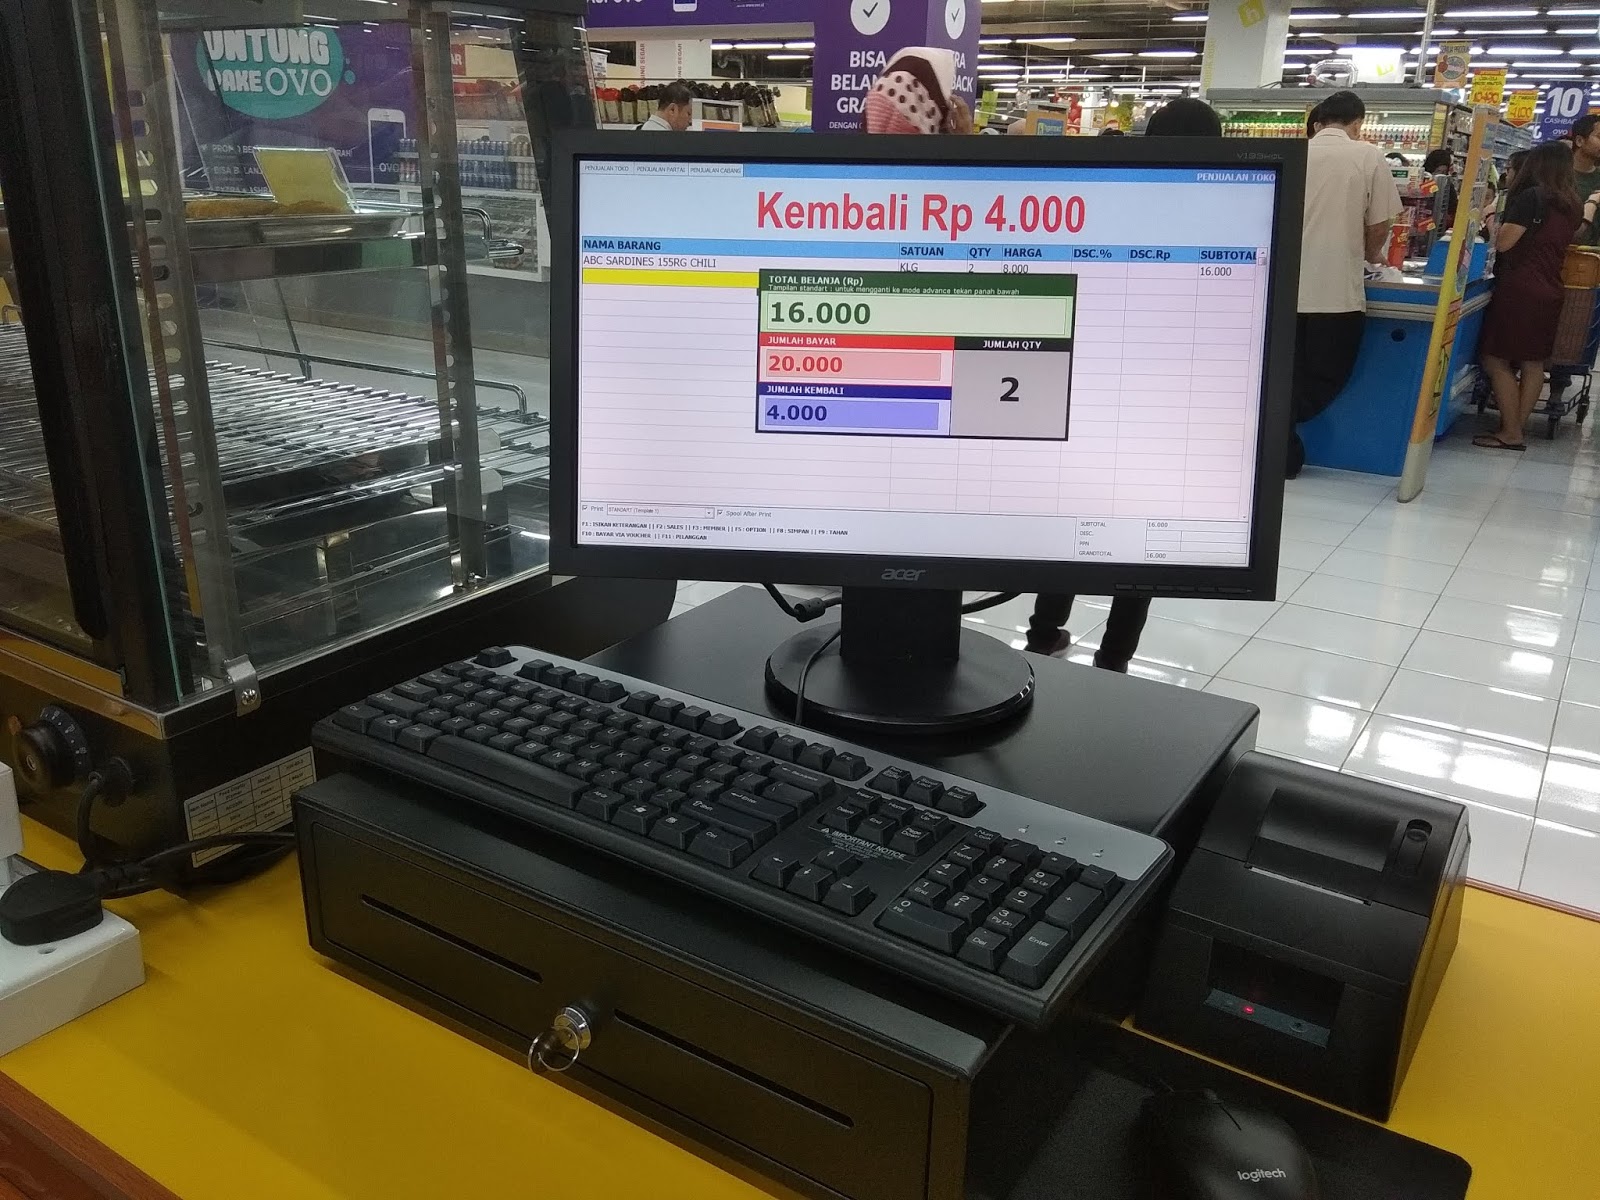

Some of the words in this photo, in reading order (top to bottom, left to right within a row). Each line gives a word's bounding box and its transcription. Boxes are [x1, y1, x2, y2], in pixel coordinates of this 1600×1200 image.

[203, 28, 330, 65] UNTUNG
[850, 51, 887, 68] BISA
[265, 67, 332, 97] OVO
[831, 74, 876, 91] BELA
[829, 121, 858, 129] DENGAN
[1197, 172, 1249, 182] PENJUALAN
[1252, 173, 1276, 182] TOKO
[757, 191, 907, 232] Kembali
[921, 194, 973, 241] Rp
[984, 194, 1086, 233] 4.000
[583, 239, 615, 250] NAMA
[617, 240, 661, 251] BARANG
[900, 246, 944, 257] SATUAN
[969, 248, 991, 259] QTY
[1003, 248, 1042, 258] HARGA
[1073, 249, 1112, 259] DSC.%
[1130, 250, 1170, 261] DSC.Rp
[583, 255, 603, 265] ABC
[606, 256, 654, 267] SARDINES
[657, 257, 687, 267] 155RG
[690, 258, 717, 268] CHILI
[900, 263, 918, 272] KLG
[968, 264, 974, 273] 2
[1003, 264, 1029, 273] 8.000
[1200, 267, 1232, 277] 16.000
[769, 275, 799, 284] TOTAL
[801, 276, 841, 286] BELANJA
[842, 276, 864, 287] (Rp)
[768, 285, 798, 293] Tampilan
[799, 285, 828, 293] standart
[856, 287, 891, 295] mengganti
[770, 301, 871, 325] 16.000
[768, 336, 804, 345] JUMLAH
[807, 337, 837, 346] BAYAR
[983, 340, 1018, 349] JUMLAH
[1019, 340, 1042, 350] QTY
[768, 355, 843, 373] 20.000
[767, 385, 802, 394] JUMLAH
[804, 386, 844, 395] KEMBALI
[1000, 377, 1020, 402] 2
[766, 405, 827, 421] 4.000
[881, 568, 927, 581] acer
[831, 830, 877, 849] IMPORTANT
[876, 845, 907, 859] NOTICE
[1237, 1168, 1286, 1182] logitech
